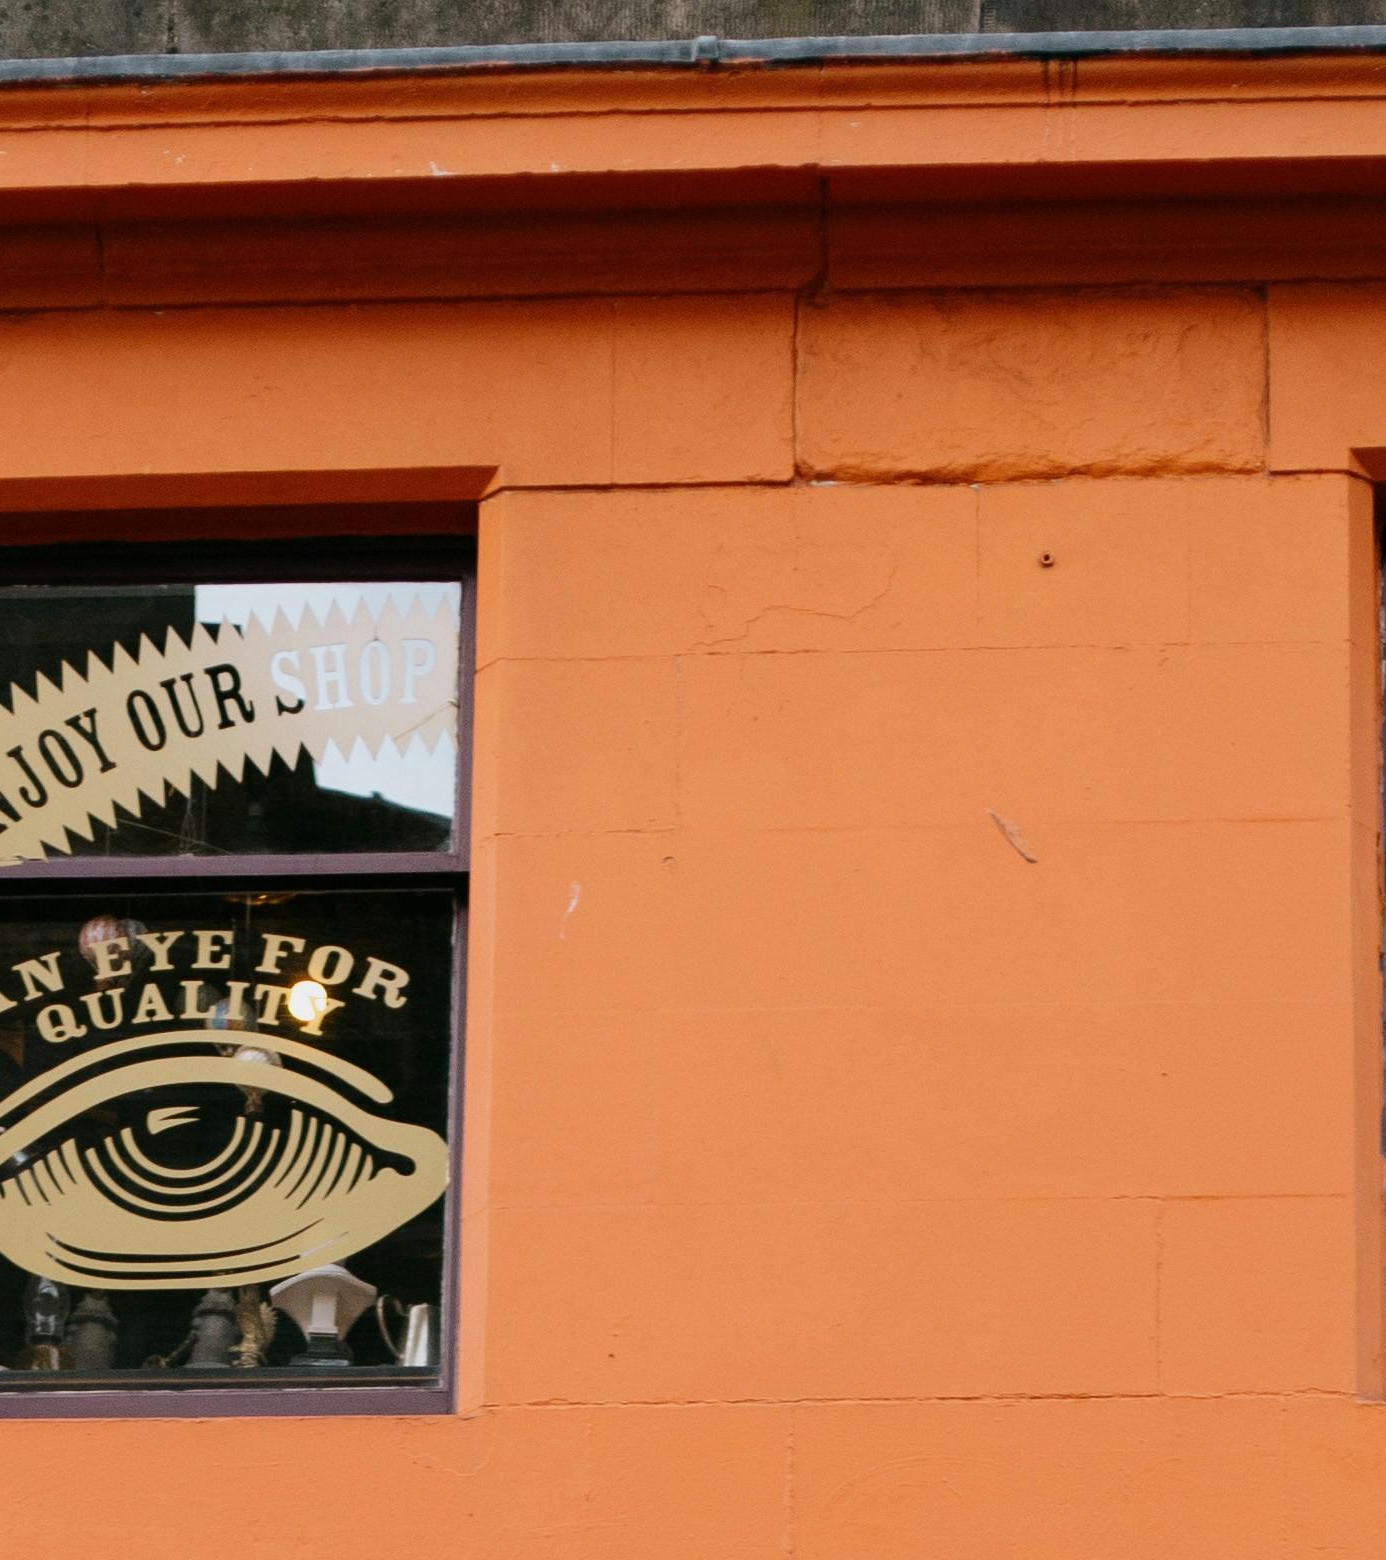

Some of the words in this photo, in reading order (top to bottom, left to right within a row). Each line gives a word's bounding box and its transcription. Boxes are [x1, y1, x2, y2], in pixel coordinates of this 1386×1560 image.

[125, 661, 255, 753] OUR
[271, 637, 437, 716] SHOP
[92, 930, 233, 980] EYE
[255, 933, 411, 1009] FOR
[38, 980, 345, 1044] QUALITY
